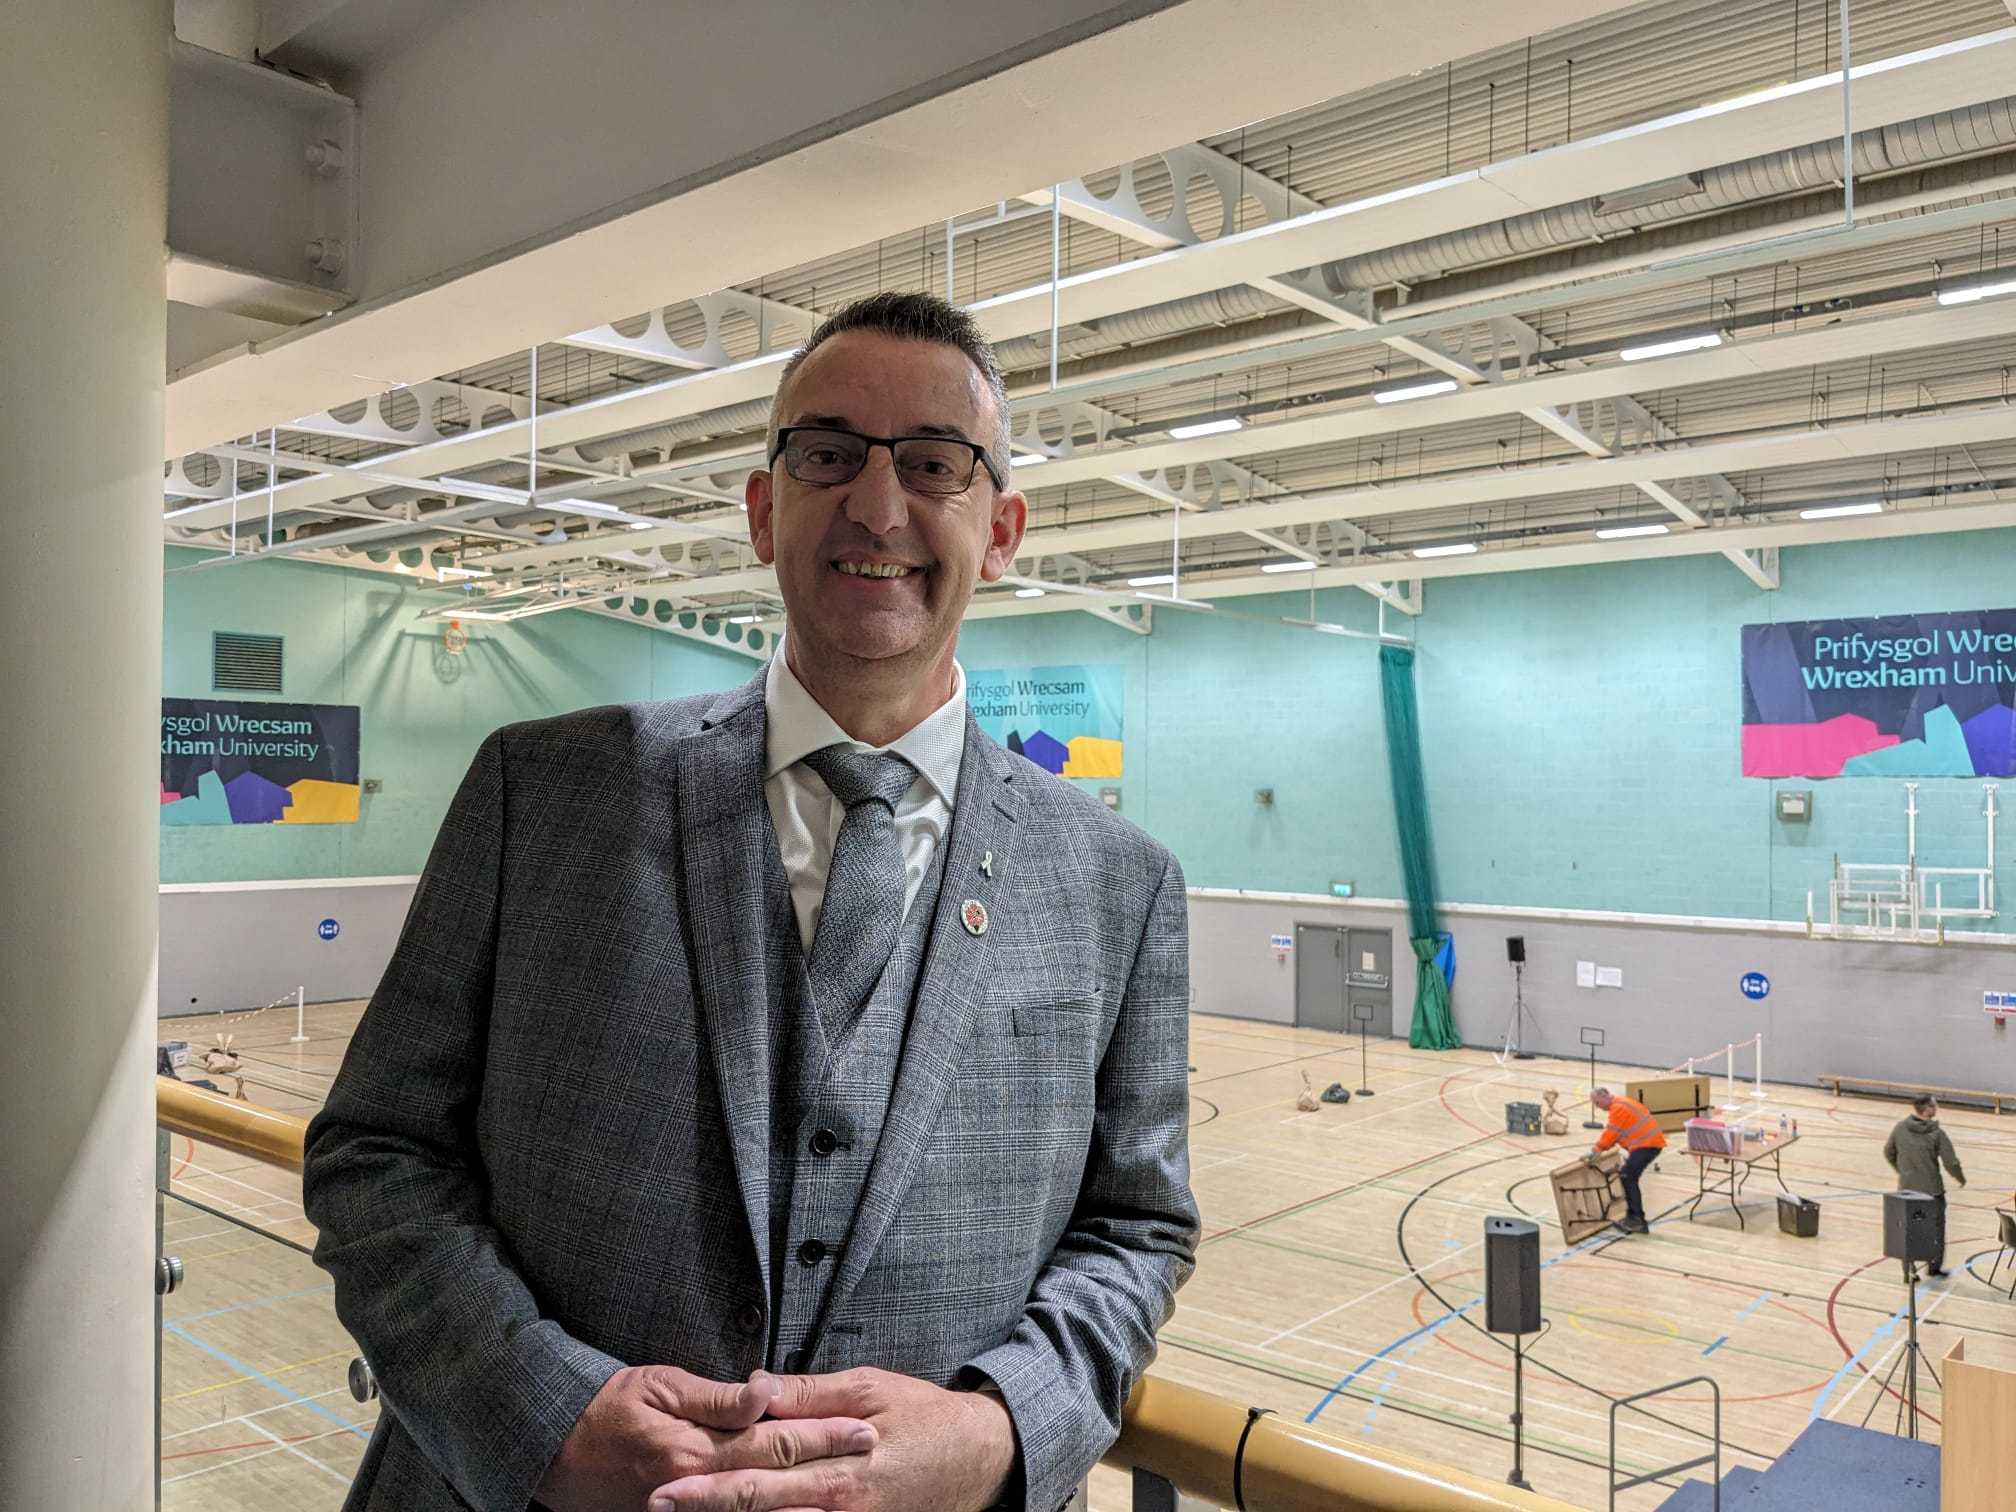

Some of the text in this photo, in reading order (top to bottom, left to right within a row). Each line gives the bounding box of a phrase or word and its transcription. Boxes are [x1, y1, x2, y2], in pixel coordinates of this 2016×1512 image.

[1815, 628, 2016, 665] Prifysgol Wre
[1801, 661, 1946, 690] Wrexham
[1017, 680, 1085, 697] Wrecsam
[1019, 701, 1090, 719] University
[214, 713, 312, 735] Wrecsam
[219, 738, 319, 761] University
